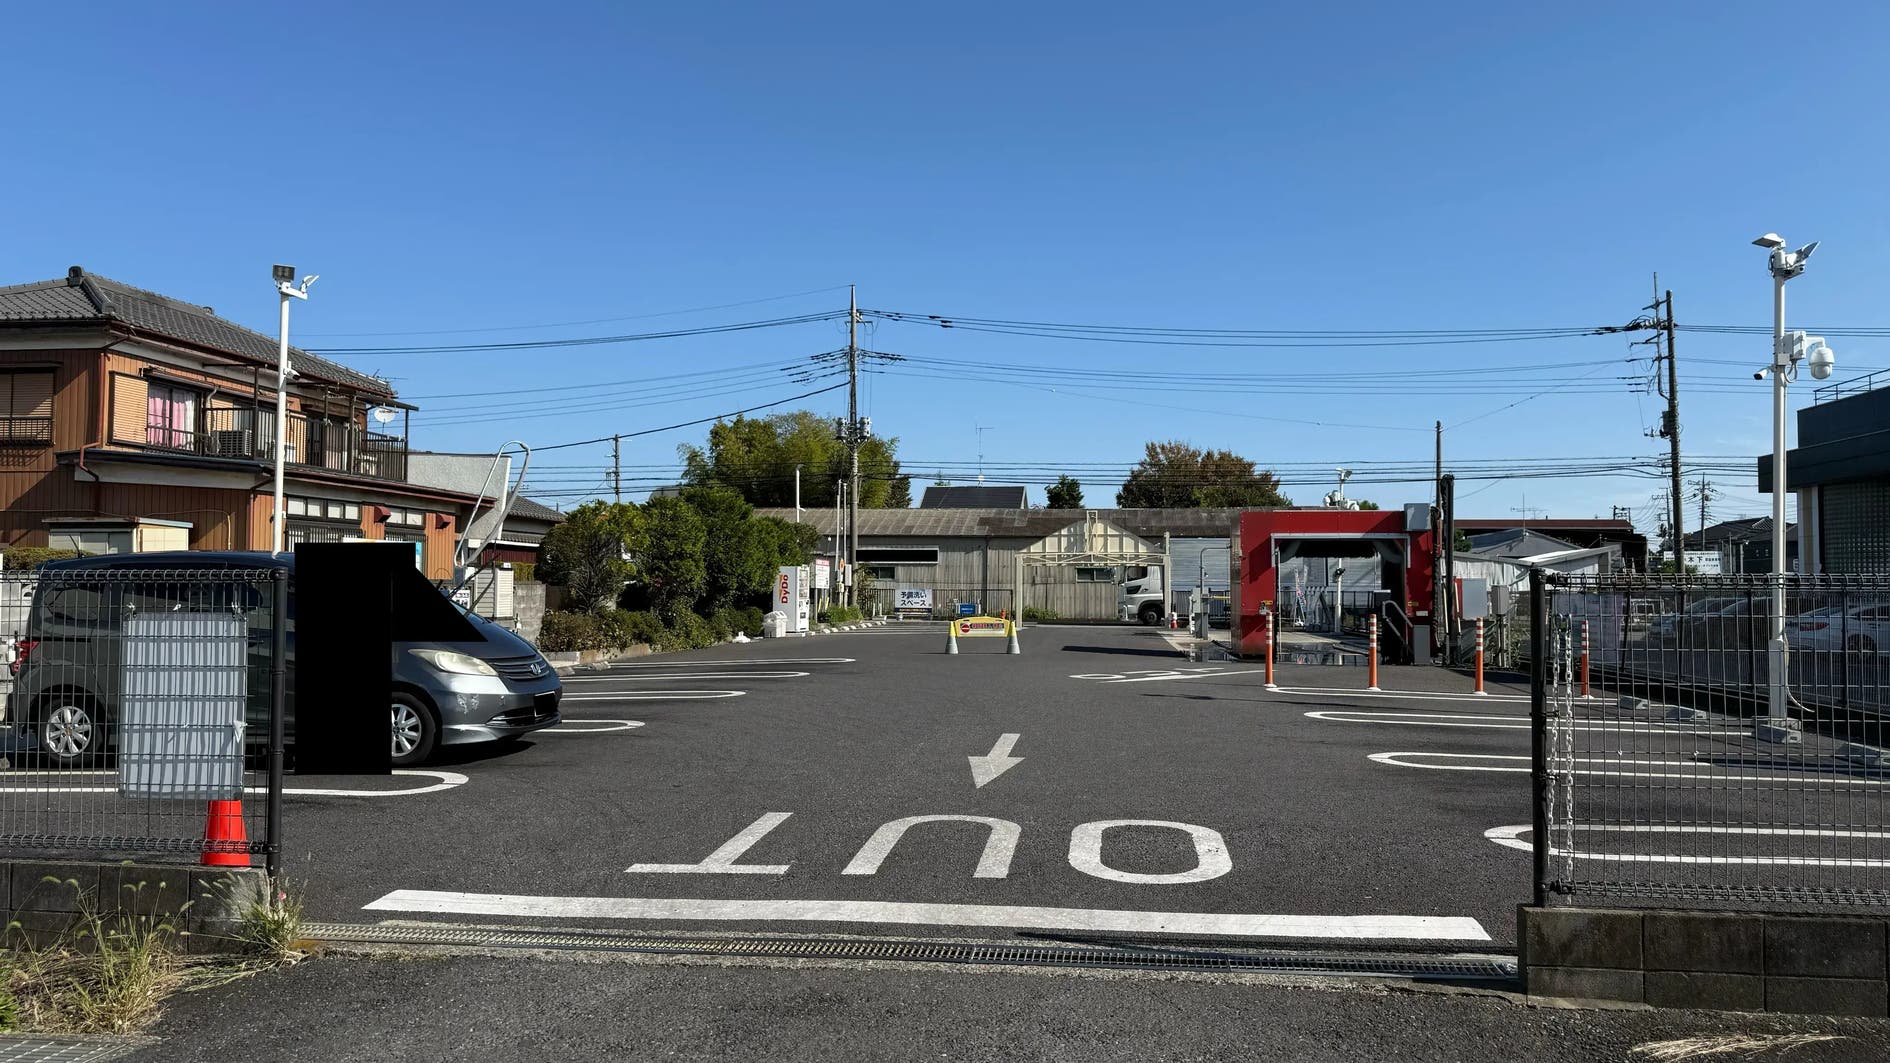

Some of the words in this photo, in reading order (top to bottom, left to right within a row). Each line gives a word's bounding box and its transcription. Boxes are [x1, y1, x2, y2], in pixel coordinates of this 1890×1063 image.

[781, 574, 790, 604] DyDo
[900, 599, 927, 607] スペース
[1069, 667, 1225, 679] OUT
[623, 811, 1233, 885] OUT
